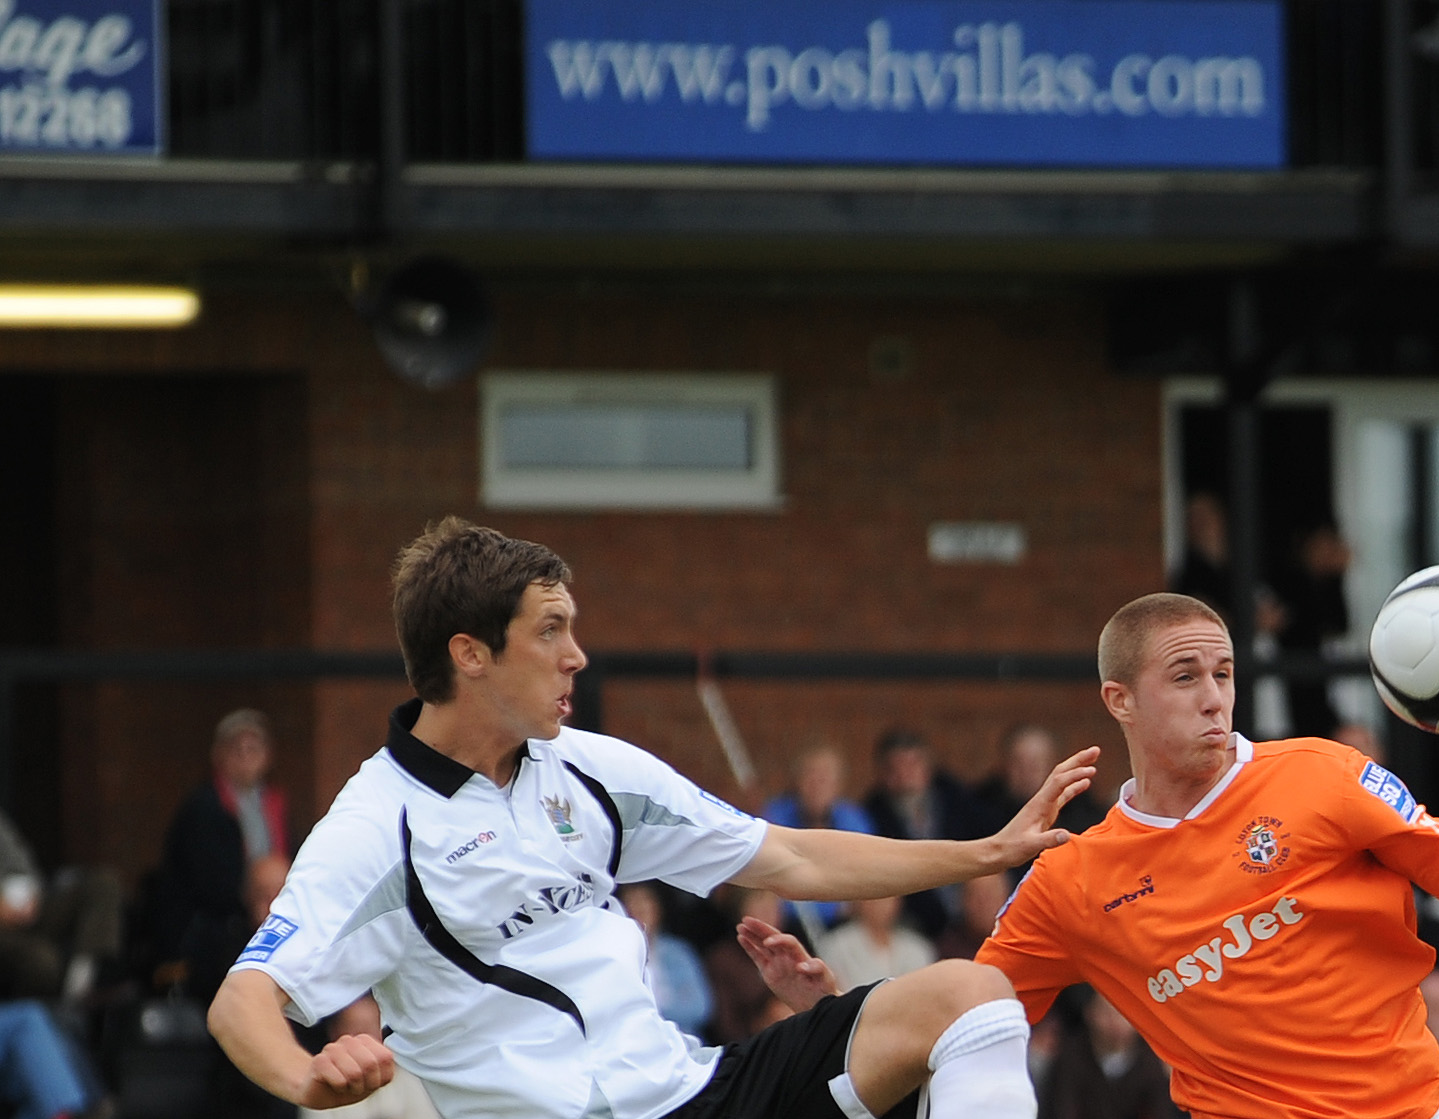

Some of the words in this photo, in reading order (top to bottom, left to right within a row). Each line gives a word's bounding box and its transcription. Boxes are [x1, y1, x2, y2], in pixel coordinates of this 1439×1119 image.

[0, 0, 148, 94] age
[548, 20, 1265, 131] www.poshvillas.com
[445, 830, 497, 864] macron
[1147, 894, 1303, 1003] easyJet
